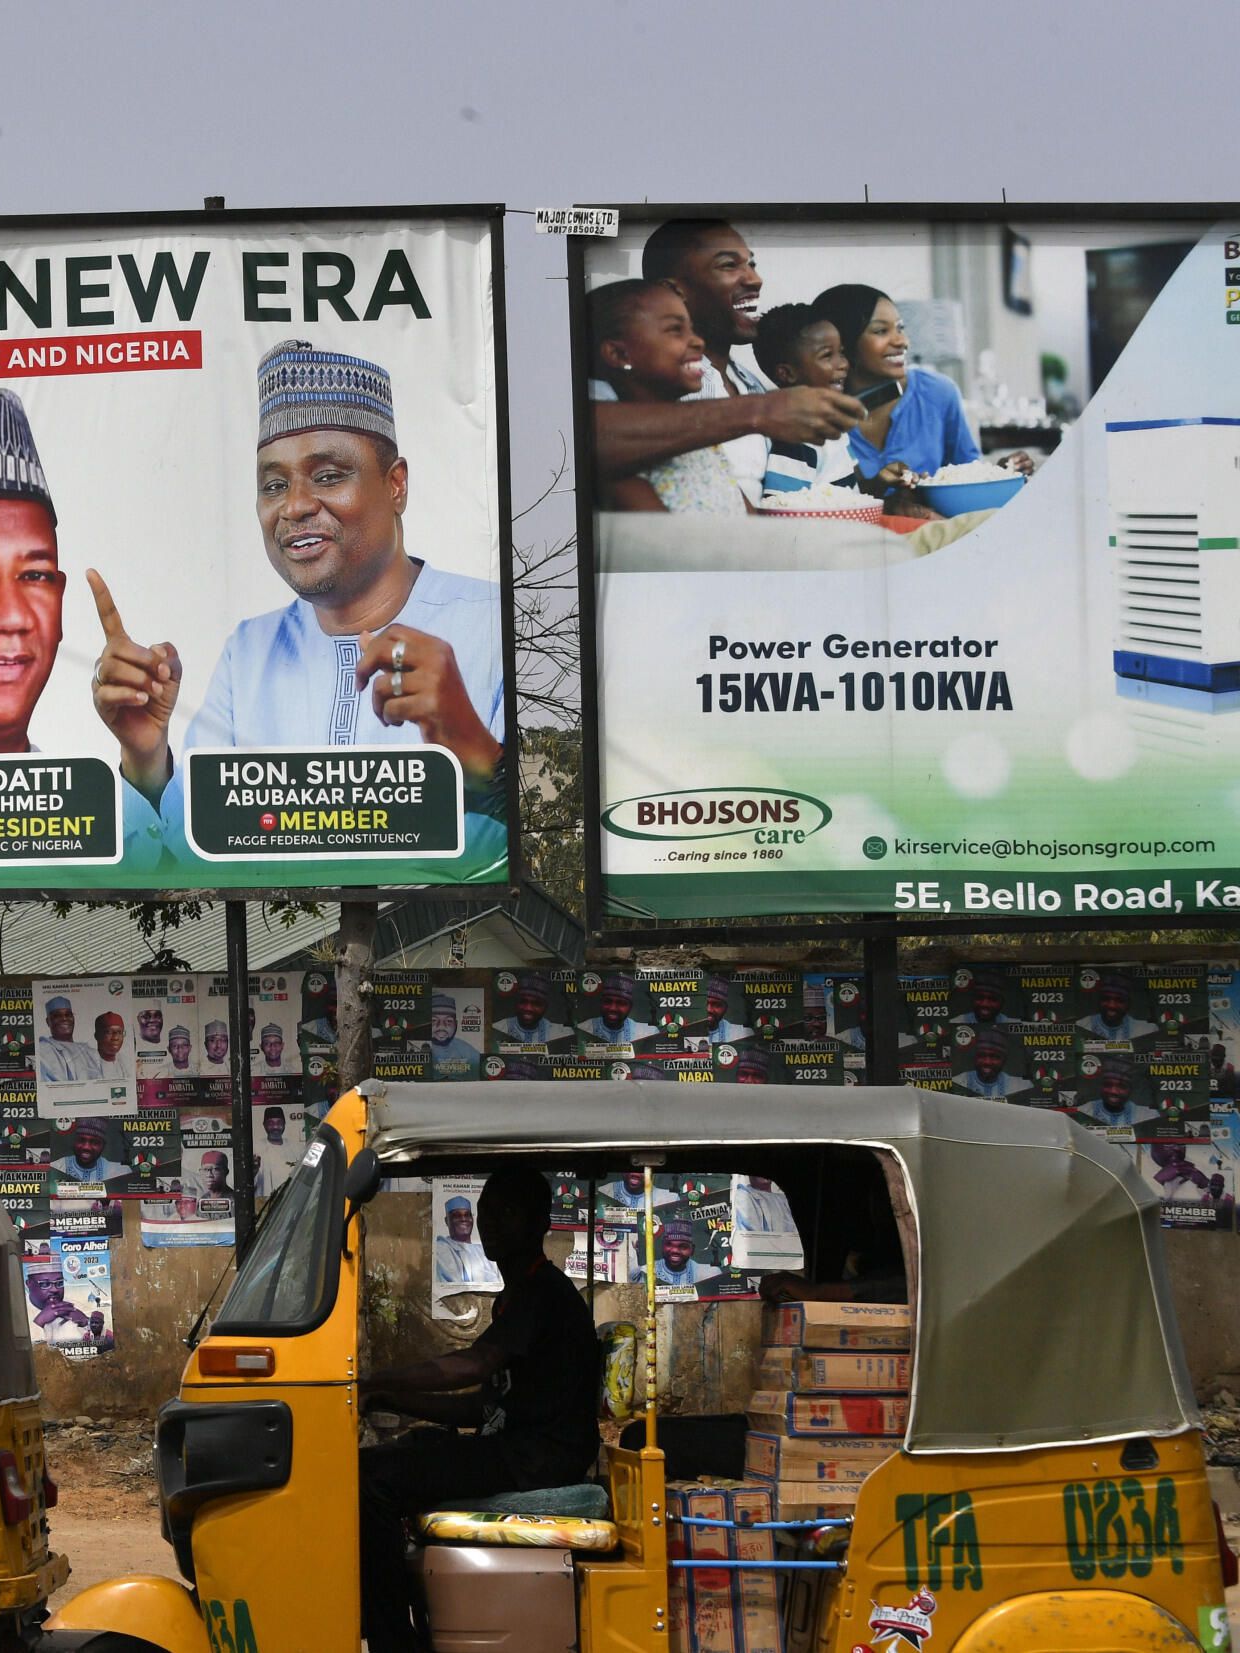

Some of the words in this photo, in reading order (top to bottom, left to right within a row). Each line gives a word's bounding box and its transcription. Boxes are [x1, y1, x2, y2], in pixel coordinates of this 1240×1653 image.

[537, 211, 566, 224] MAJOR
[595, 212, 615, 225] LTD.
[242, 249, 432, 322] ERA
[7, 344, 70, 370] AND
[77, 339, 189, 366] NIGERIA
[708, 634, 812, 662] Power
[822, 633, 999, 659] Generator
[696, 670, 1013, 714] 15KVA-1010KVA
[219, 761, 297, 786] HON.
[306, 759, 427, 785] SHU'AIB
[225, 787, 345, 807] ABUBAKAR
[351, 786, 423, 804] FAGGE
[637, 799, 801, 828] BHOJSONS
[279, 809, 388, 831] MEMBER
[227, 834, 267, 846] FAGGE
[270, 833, 324, 846] FEDERAL
[327, 832, 421, 845] CONSTITUENCY
[753, 824, 807, 846] care
[12, 840, 28, 851] OF
[31, 839, 83, 851] NIGERIA
[894, 836, 1216, 860] kirservice@bhojsonsgroup.com
[714, 849, 748, 862] since
[751, 848, 783, 861] 1860
[894, 880, 952, 913] 5E,
[964, 880, 1061, 913] Bello
[1074, 880, 1184, 914] Road,
[650, 982, 697, 992] NABAYYE
[1022, 977, 1070, 988] NABAYYE
[1149, 979, 1196, 989] NABAYYE
[375, 985, 422, 995] NABAYYE
[745, 984, 792, 994] NABAYYE
[660, 997, 691, 1007] 2023
[1032, 993, 1063, 1003] 2023
[1159, 994, 1190, 1004] 2023
[384, 1000, 415, 1010] 2023
[755, 999, 786, 1009] 2023
[917, 1007, 949, 1017] 2023
[1, 1016, 33, 1025] 2023
[1024, 1035, 1071, 1045] NABAYYE
[785, 1054, 834, 1064] NABAYYE
[1034, 1051, 1065, 1061] 2023
[376, 1065, 423, 1076] NABAYYE
[553, 1068, 601, 1078] NABAYYE
[796, 1069, 827, 1080] 2023
[1150, 1065, 1199, 1075] NABAYYE
[1160, 1081, 1192, 1091] 2023
[3, 1108, 35, 1118] 2023
[124, 1121, 171, 1131] NABAYYE
[133, 1137, 164, 1147] 2023
[2, 1199, 33, 1209] 2023
[1165, 1207, 1216, 1217] MEMBER
[56, 1217, 106, 1226] MEMBER
[62, 1242, 82, 1251] Goro
[83, 1240, 108, 1251] Alheri
[896, 1491, 983, 1591] TFA
